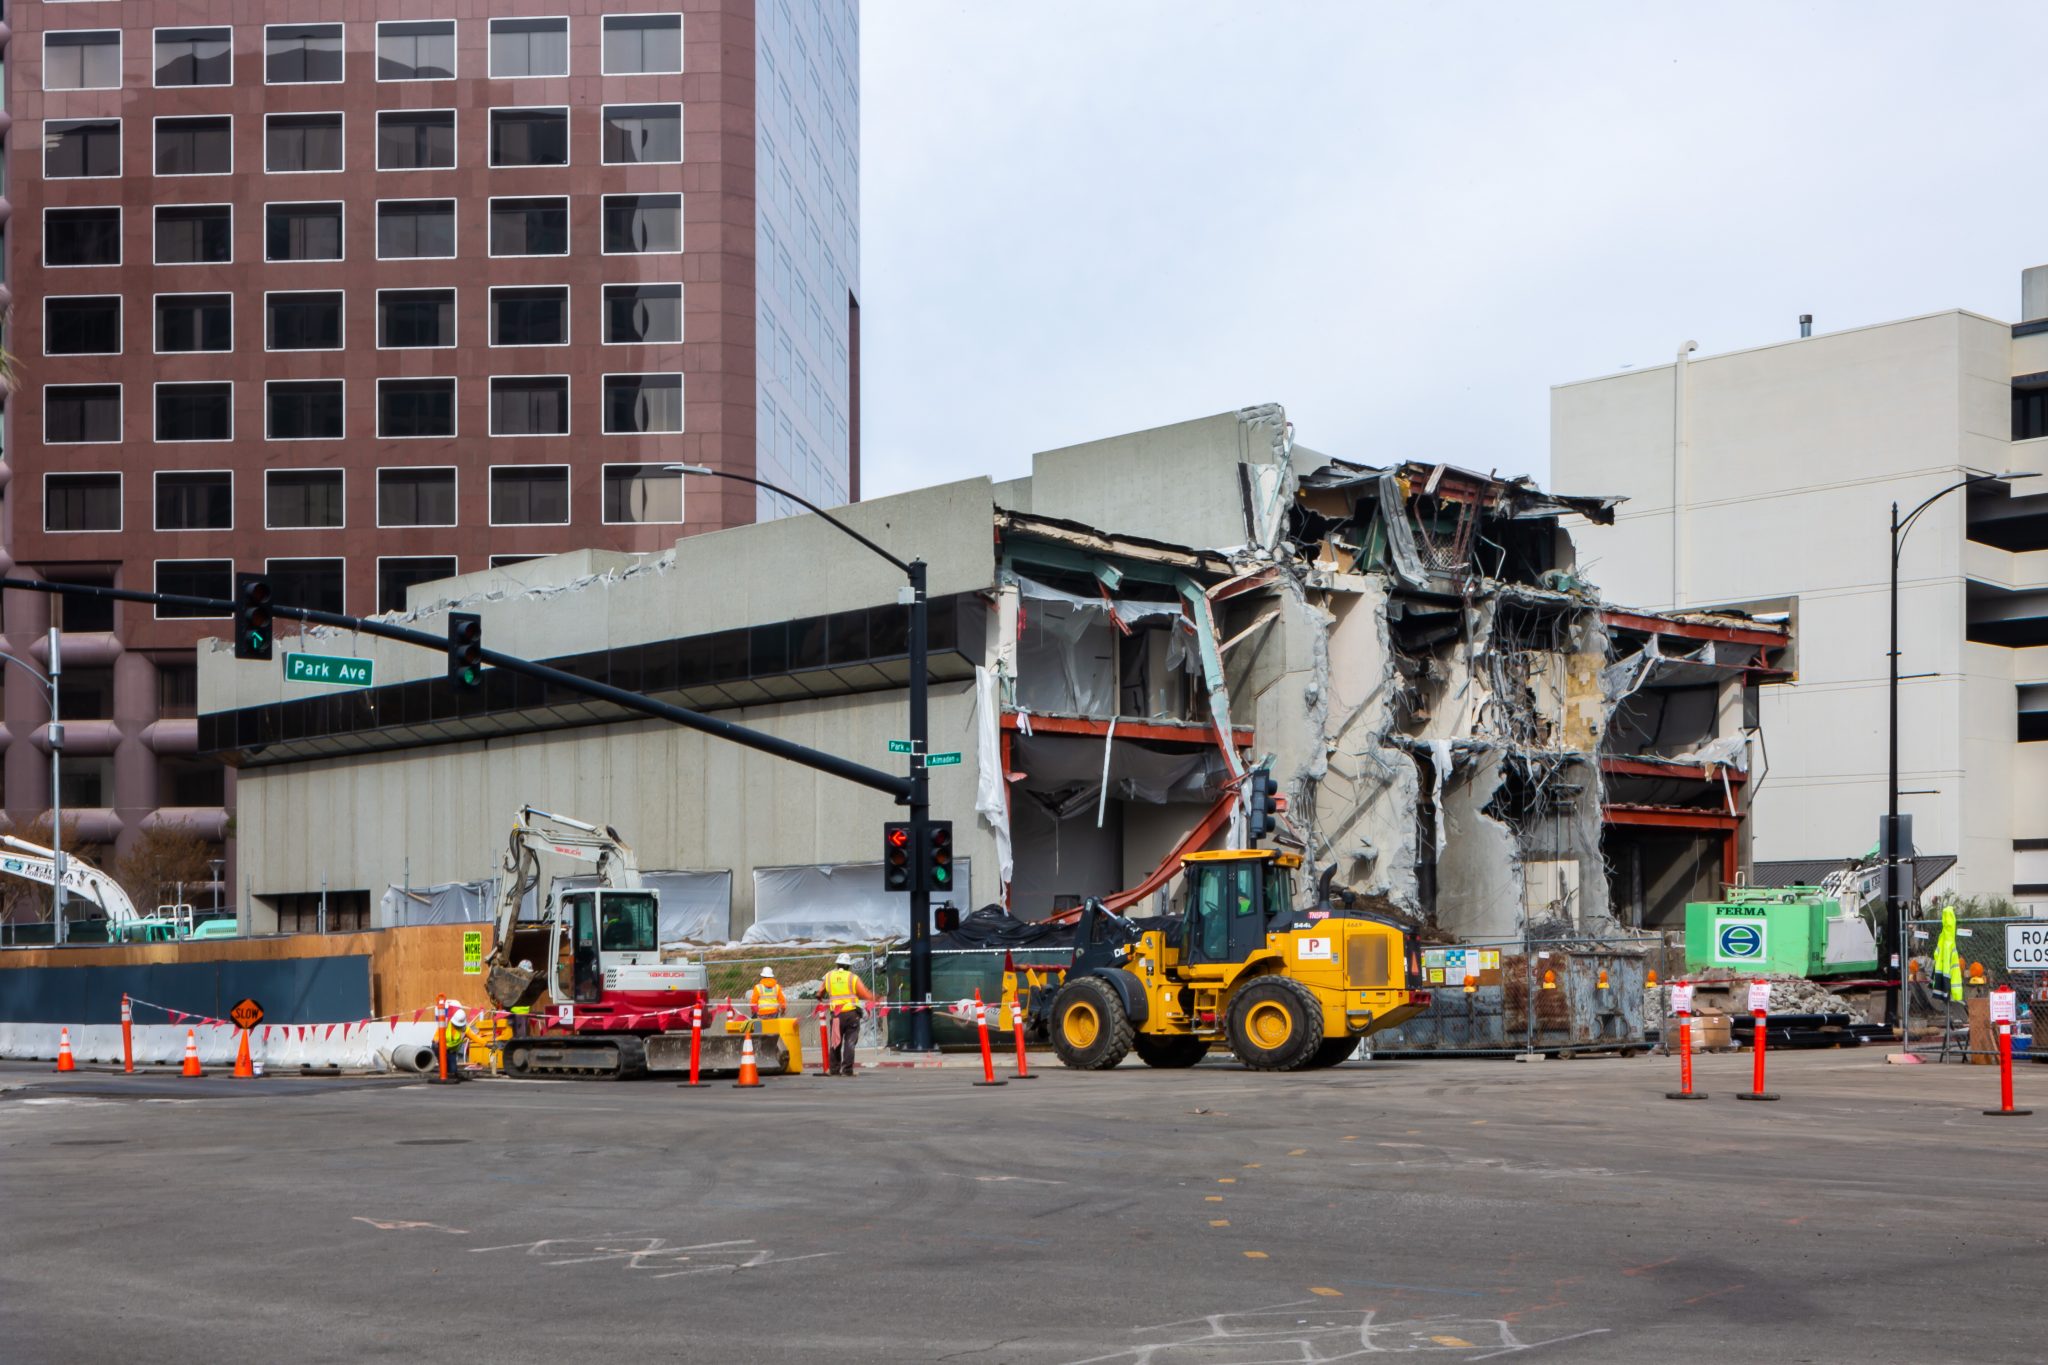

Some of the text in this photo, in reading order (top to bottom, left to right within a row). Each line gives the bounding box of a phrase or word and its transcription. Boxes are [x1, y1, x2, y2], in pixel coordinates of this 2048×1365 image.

[294, 660, 366, 679] Park Ave
[890, 742, 905, 751] Park
[25, 863, 73, 880] FERA
[1716, 906, 1766, 916] FERMA
[464, 943, 480, 955] NICHE
[235, 1007, 259, 1020] SLOW
